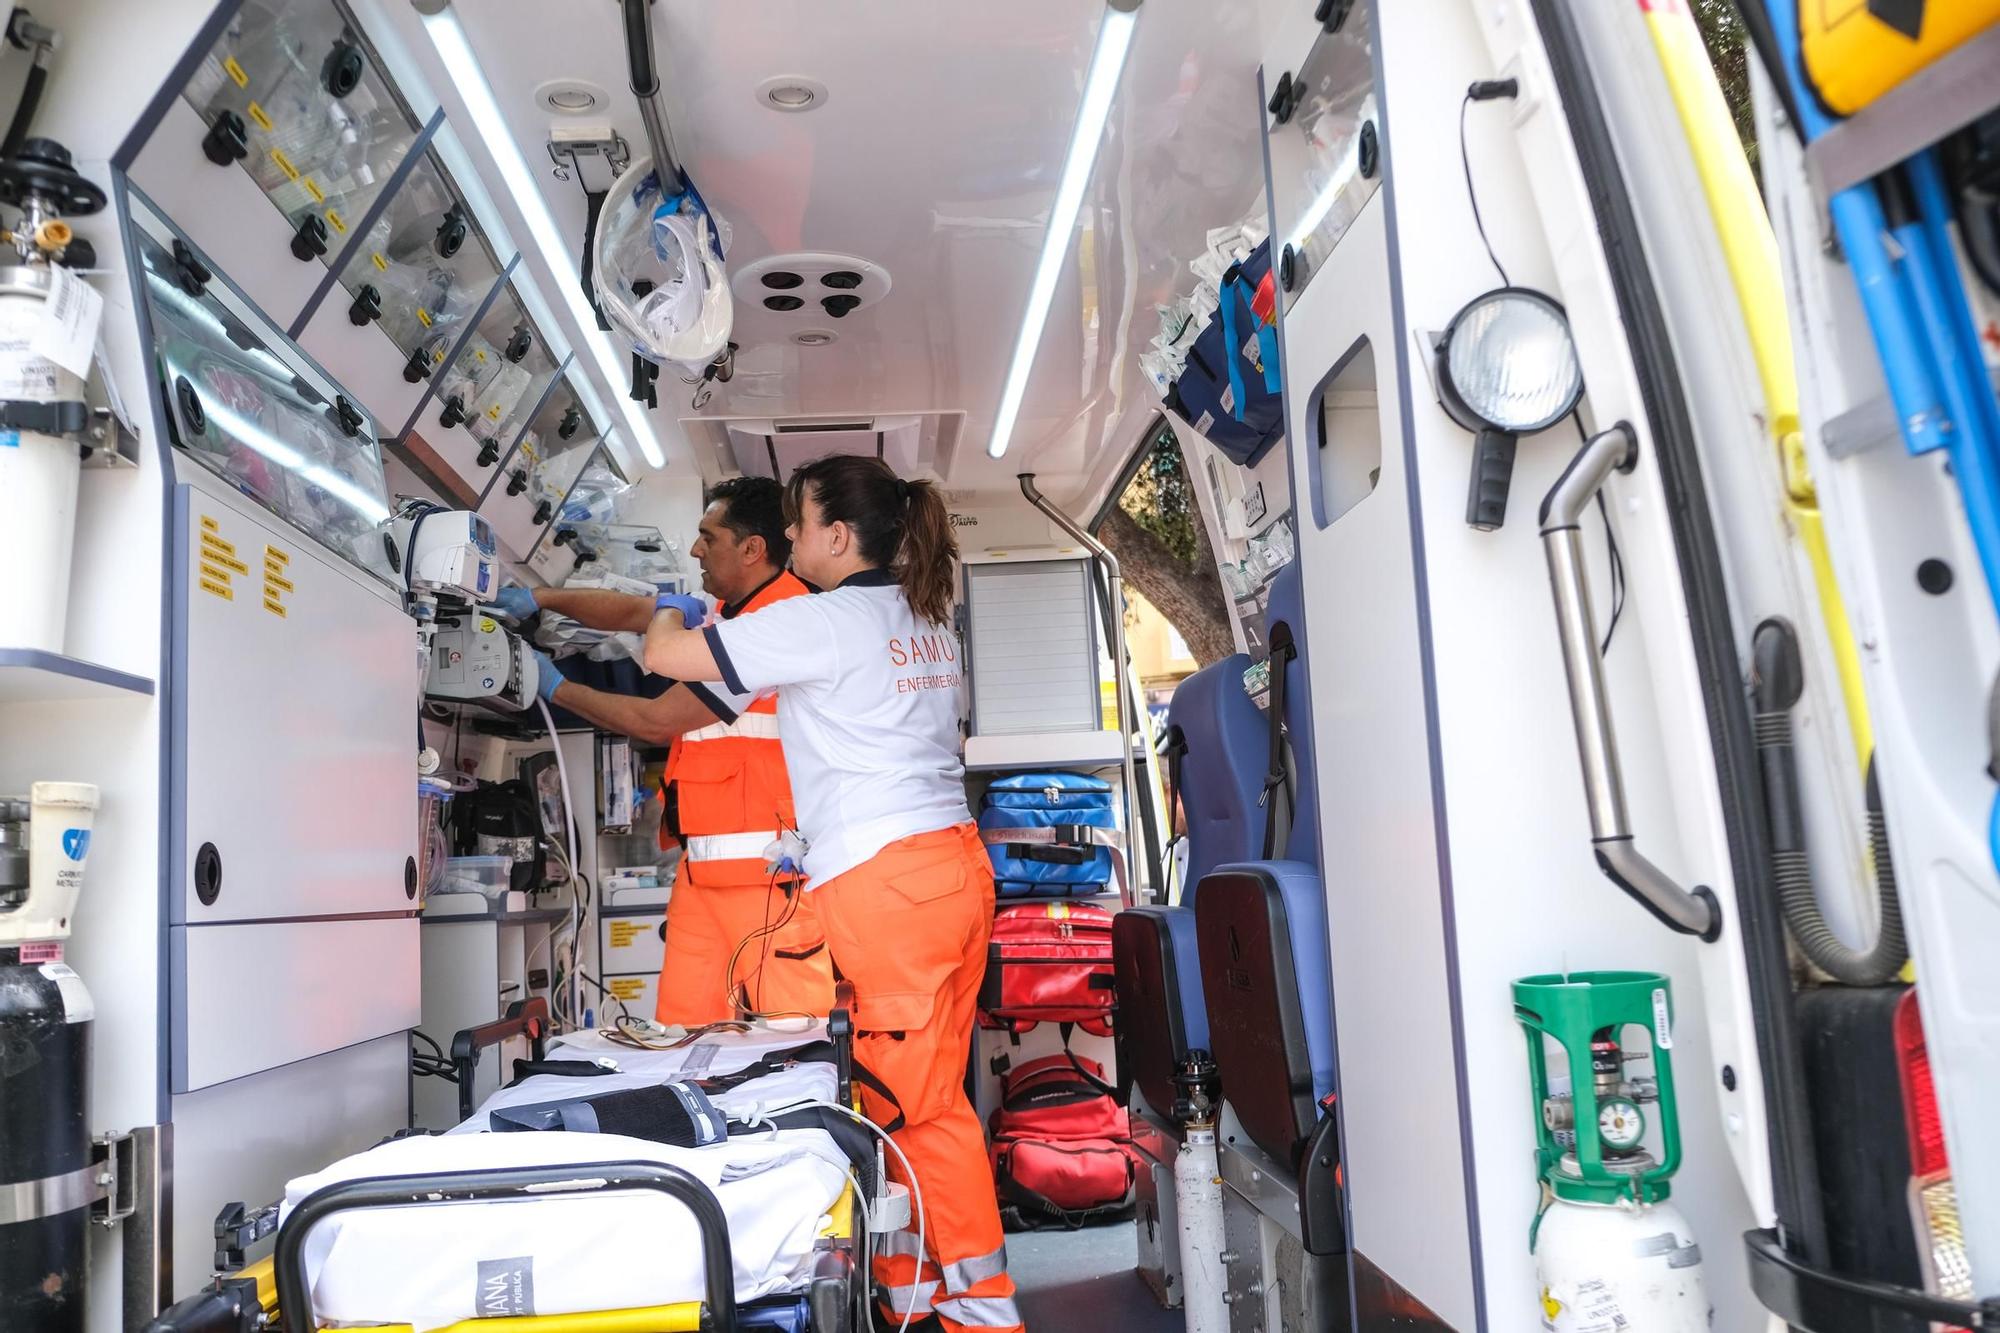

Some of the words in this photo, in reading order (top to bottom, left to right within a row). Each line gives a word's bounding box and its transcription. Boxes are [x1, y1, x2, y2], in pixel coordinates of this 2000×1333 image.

[889, 634, 956, 667] SAMU
[897, 671, 962, 693] ENFERMERÍA
[512, 1270, 523, 1304] PÚBLICA
